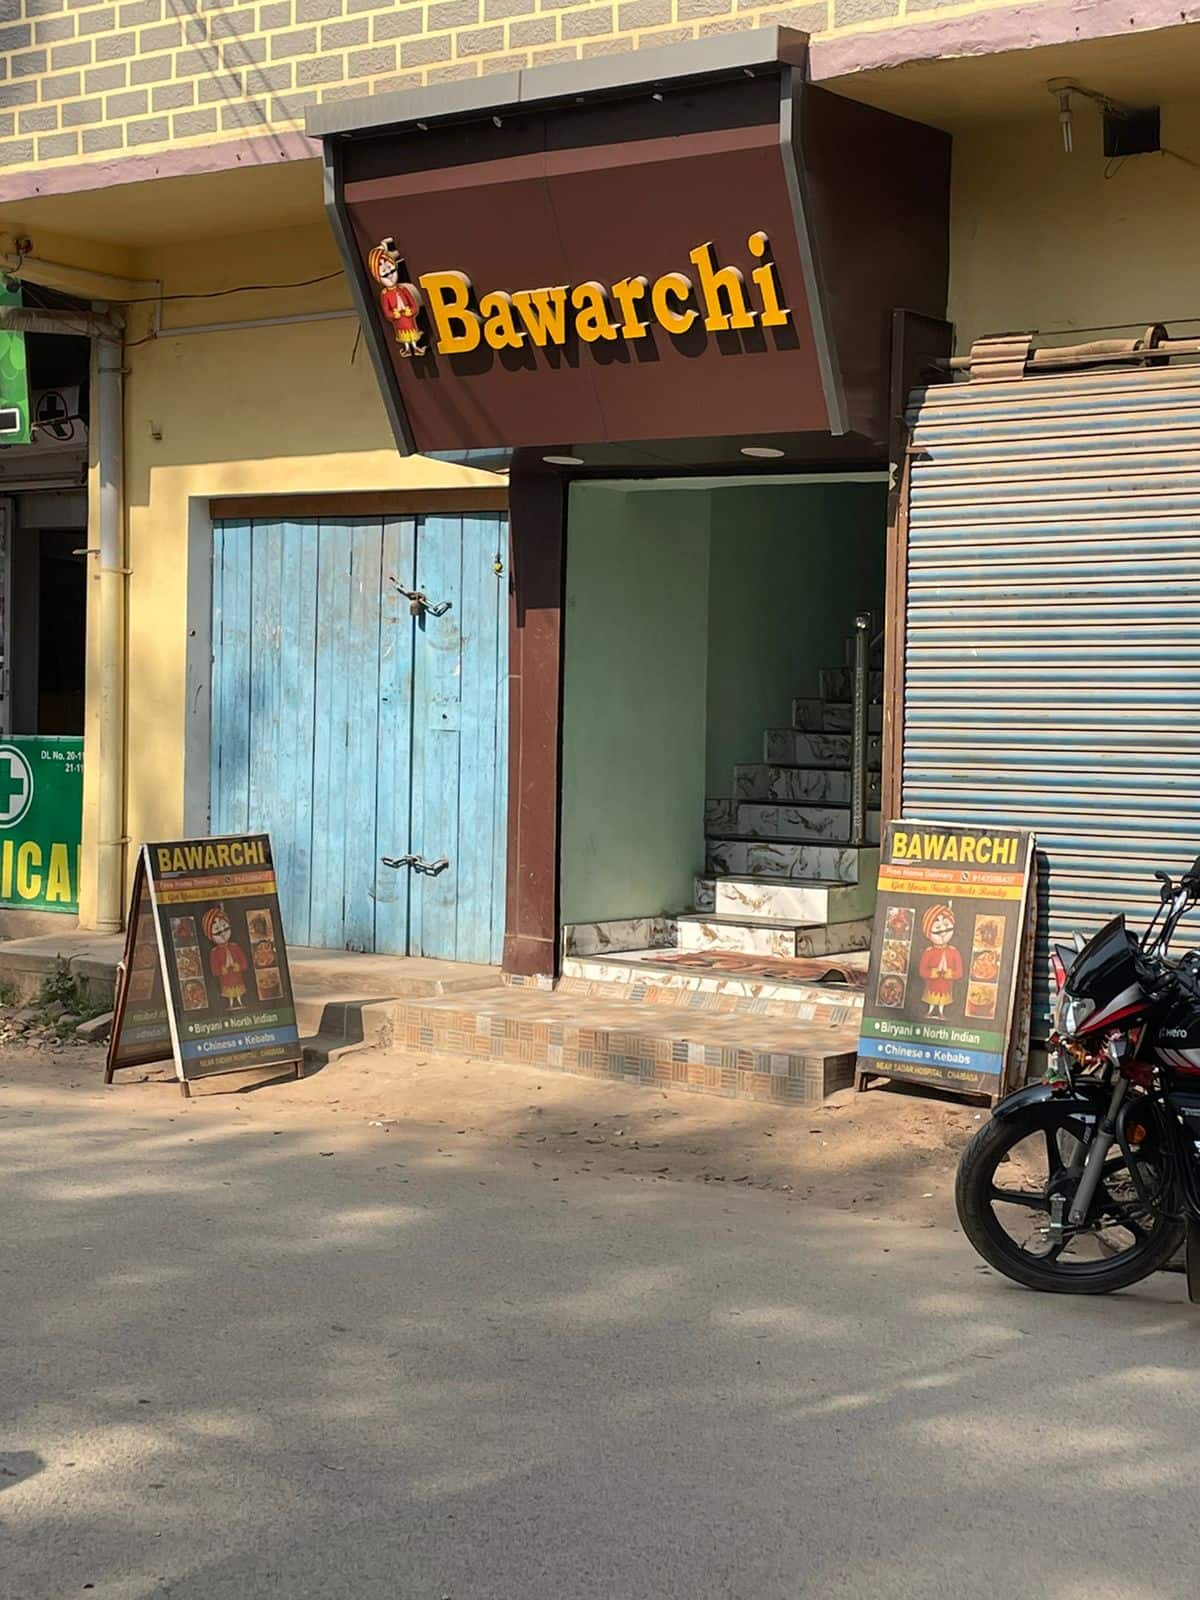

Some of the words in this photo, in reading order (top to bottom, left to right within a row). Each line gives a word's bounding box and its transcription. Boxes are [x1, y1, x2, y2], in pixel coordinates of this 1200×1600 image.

[418, 230, 791, 355] Bawarchi
[41, 750, 51, 760] DL
[52, 751, 65, 760] No.
[66, 751, 84, 761] 20-1
[157, 841, 265, 872] BAWARCHI
[892, 832, 1018, 865] BAWARCHI
[195, 1021, 223, 1034] Biryani
[230, 1016, 252, 1028] North
[253, 1013, 278, 1024] Indian
[880, 1021, 913, 1036] Biryani
[923, 1027, 949, 1040] North
[951, 1030, 980, 1044] Indian
[203, 1038, 236, 1052] Chinese
[245, 1034, 275, 1045] Kebabs
[885, 1044, 923, 1058] Chinese
[934, 1050, 971, 1064] Kebabs
